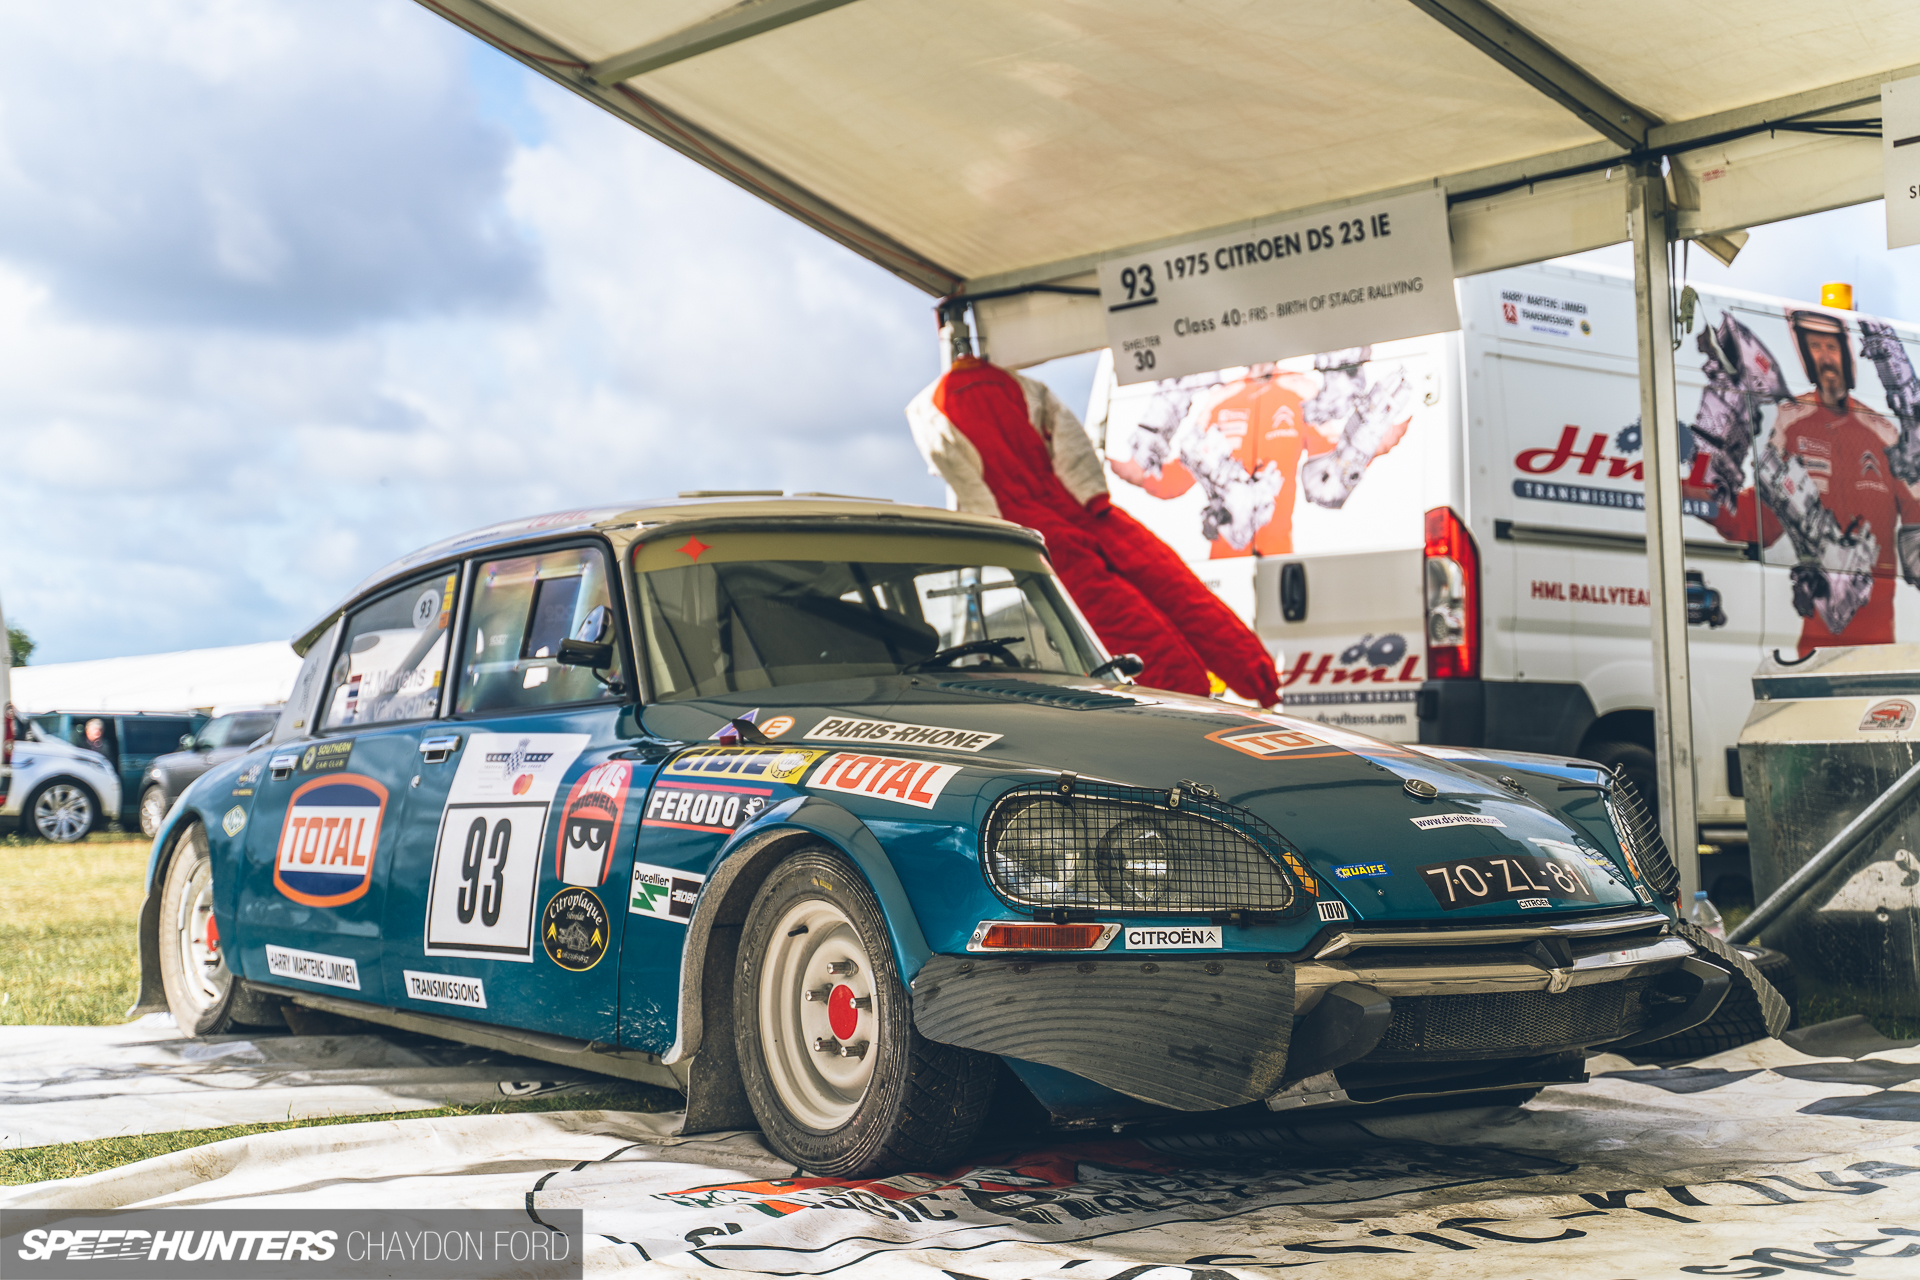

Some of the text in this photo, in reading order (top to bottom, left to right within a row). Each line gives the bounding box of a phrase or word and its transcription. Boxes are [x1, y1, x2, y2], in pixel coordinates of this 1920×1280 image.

[1164, 212, 1391, 281] 1975 CITROEN DS 23 IE
[1120, 263, 1156, 300] 93
[1173, 316, 1216, 337] Class
[1221, 308, 1247, 328] 40:
[1249, 306, 1268, 322] FRS
[1277, 299, 1307, 318] BIRTH
[1309, 295, 1326, 312] OF
[1328, 287, 1365, 309] STAGE
[1367, 277, 1424, 302] RALLYING
[1122, 335, 1161, 352] SHELTER
[1134, 349, 1156, 371] 30
[1531, 581, 1566, 602] HML
[419, 599, 433, 619] 93
[762, 720, 787, 735] E
[814, 719, 993, 750] PARIS-RHONE
[317, 741, 352, 756] SOUTHERN
[819, 753, 941, 805] TOTAL
[568, 792, 618, 821] MICHELIN
[646, 790, 740, 828] FERODO
[1416, 814, 1501, 827] www.ds-vitesse.com
[287, 816, 367, 867] TOTAL
[456, 816, 512, 928] 93
[634, 869, 670, 886] Ducellier
[1341, 864, 1386, 877] QUAIFE
[549, 891, 603, 926] Citroplaque
[1319, 902, 1345, 920] TOW
[1129, 928, 1204, 945] CITROËN
[270, 952, 356, 984] HARRY MARTENS LIMMEN
[410, 977, 480, 1003] TRANSMISSIONS
